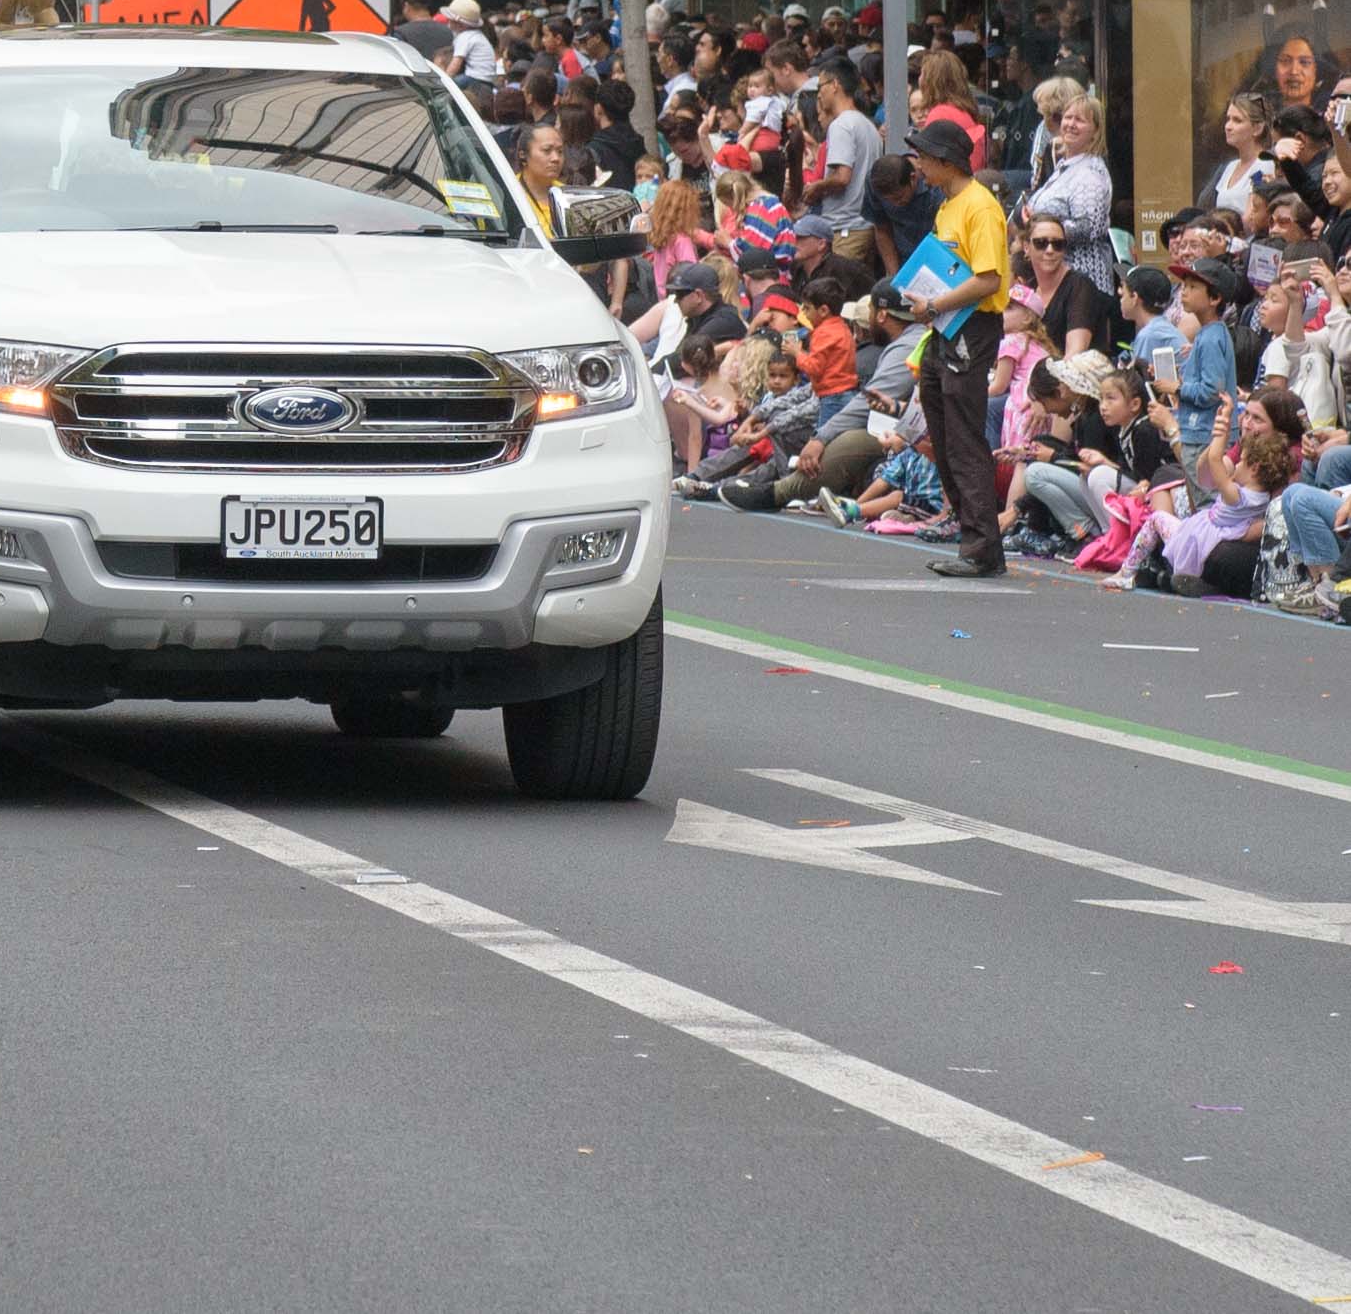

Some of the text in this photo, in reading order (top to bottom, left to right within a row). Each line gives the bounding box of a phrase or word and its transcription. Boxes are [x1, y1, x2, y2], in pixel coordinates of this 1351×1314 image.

[273, 396, 327, 421] Ford
[229, 508, 376, 546] JPU250
[266, 549, 366, 558] South Auckland Motors
